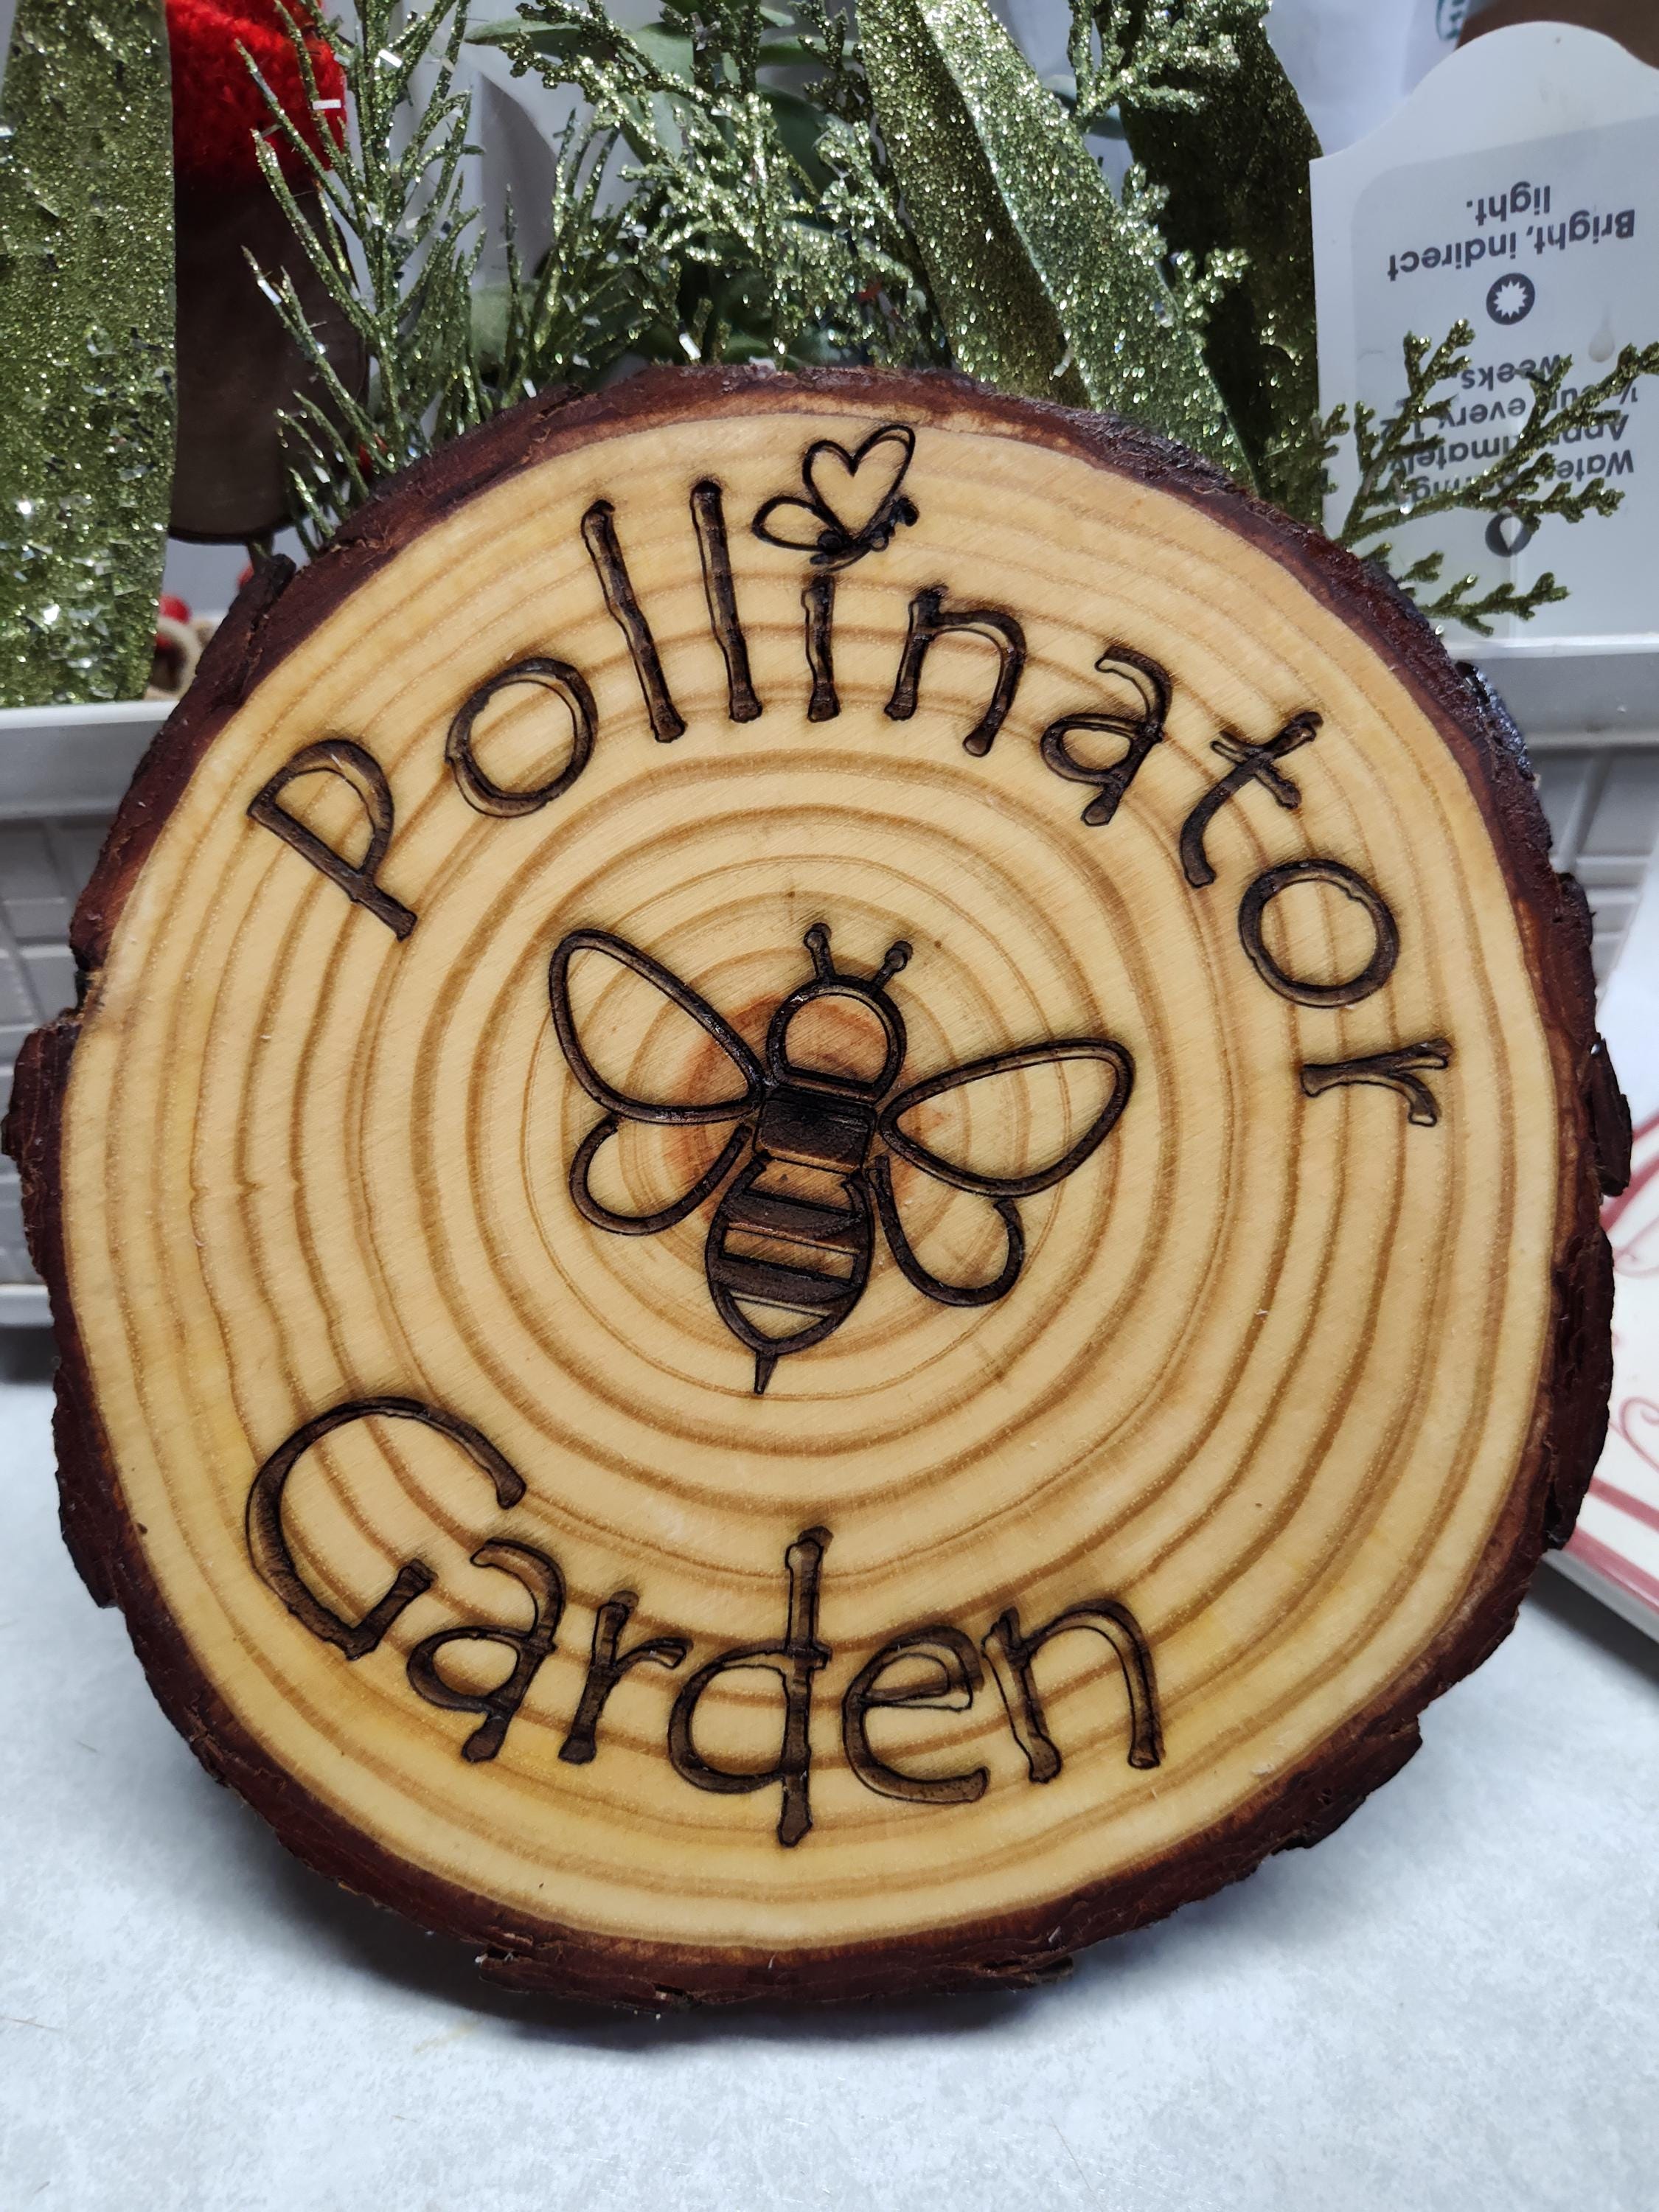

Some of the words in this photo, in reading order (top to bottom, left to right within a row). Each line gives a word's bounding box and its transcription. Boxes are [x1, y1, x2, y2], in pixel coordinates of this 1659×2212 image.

[1466, 181, 1551, 226] light.
[1526, 209, 1635, 253] Bright,
[1388, 232, 1517, 281] indirect
[1546, 449, 1634, 481] Wate
[247, 426, 1453, 1127] Pollinator
[245, 1395, 1166, 1848] Garden
